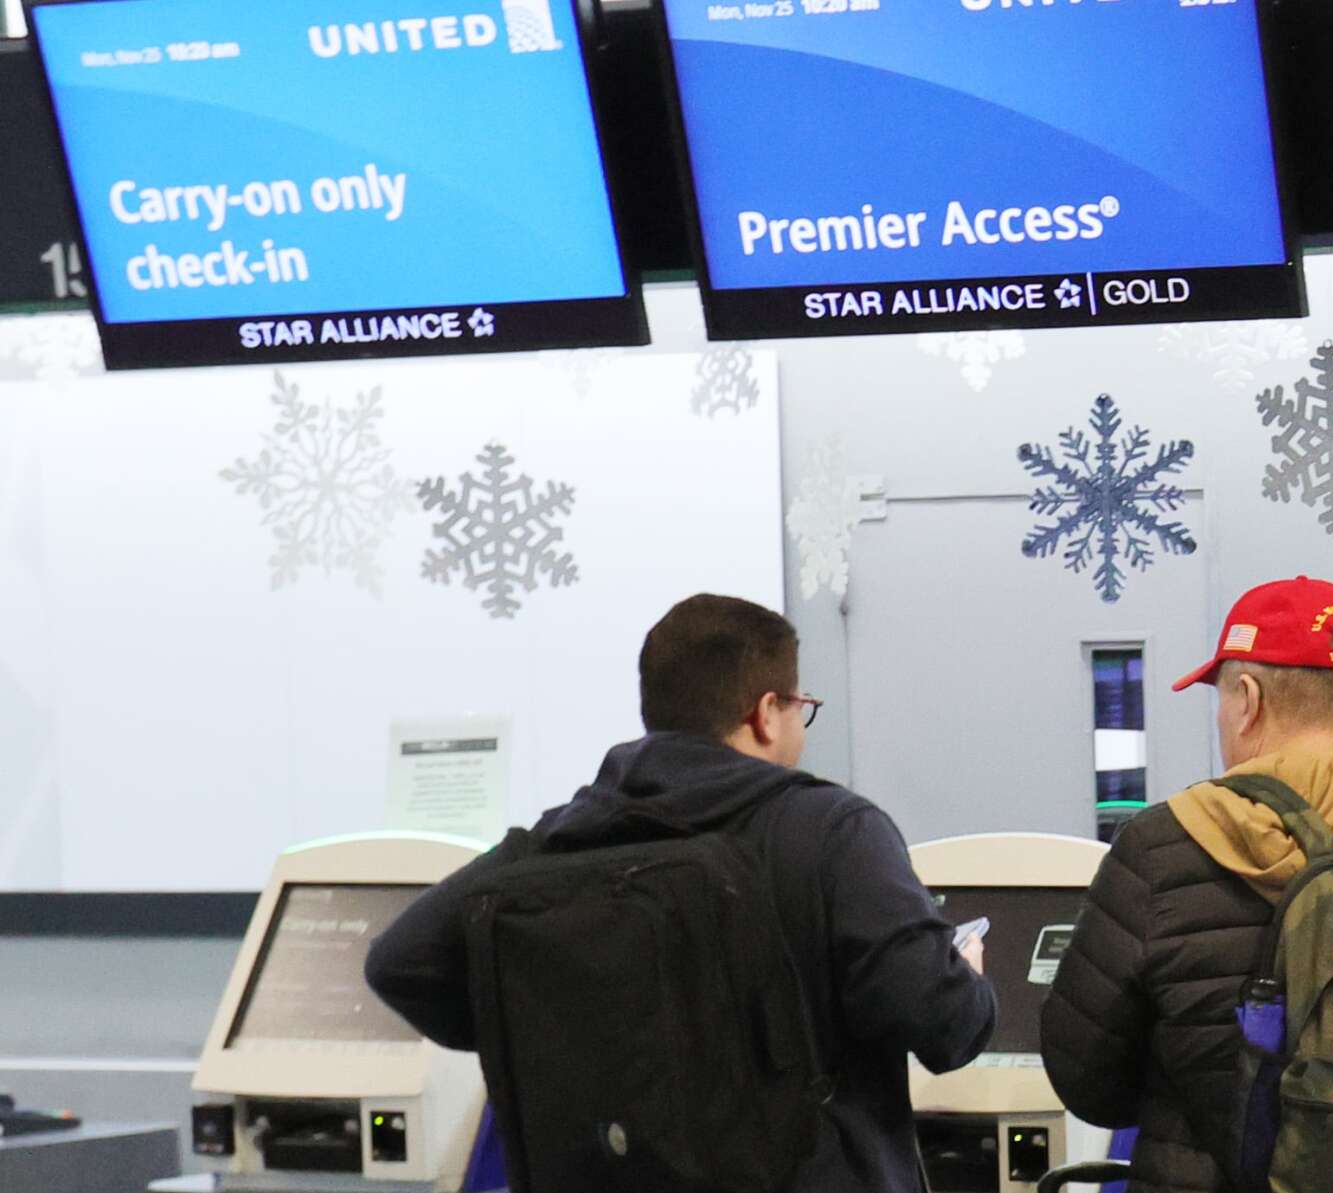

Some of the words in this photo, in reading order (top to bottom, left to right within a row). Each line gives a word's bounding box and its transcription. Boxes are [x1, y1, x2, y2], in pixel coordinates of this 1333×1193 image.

[308, 14, 497, 57] UNITED
[109, 179, 302, 231] Carry-on
[311, 163, 406, 220] only
[738, 204, 926, 255] Premier
[126, 239, 309, 290] check-in
[804, 291, 882, 318] STAR
[891, 283, 1045, 314] ALLIANCE
[1103, 278, 1190, 305] GOLD
[239, 319, 314, 348] STAR
[320, 312, 462, 345] ALLIANCE
